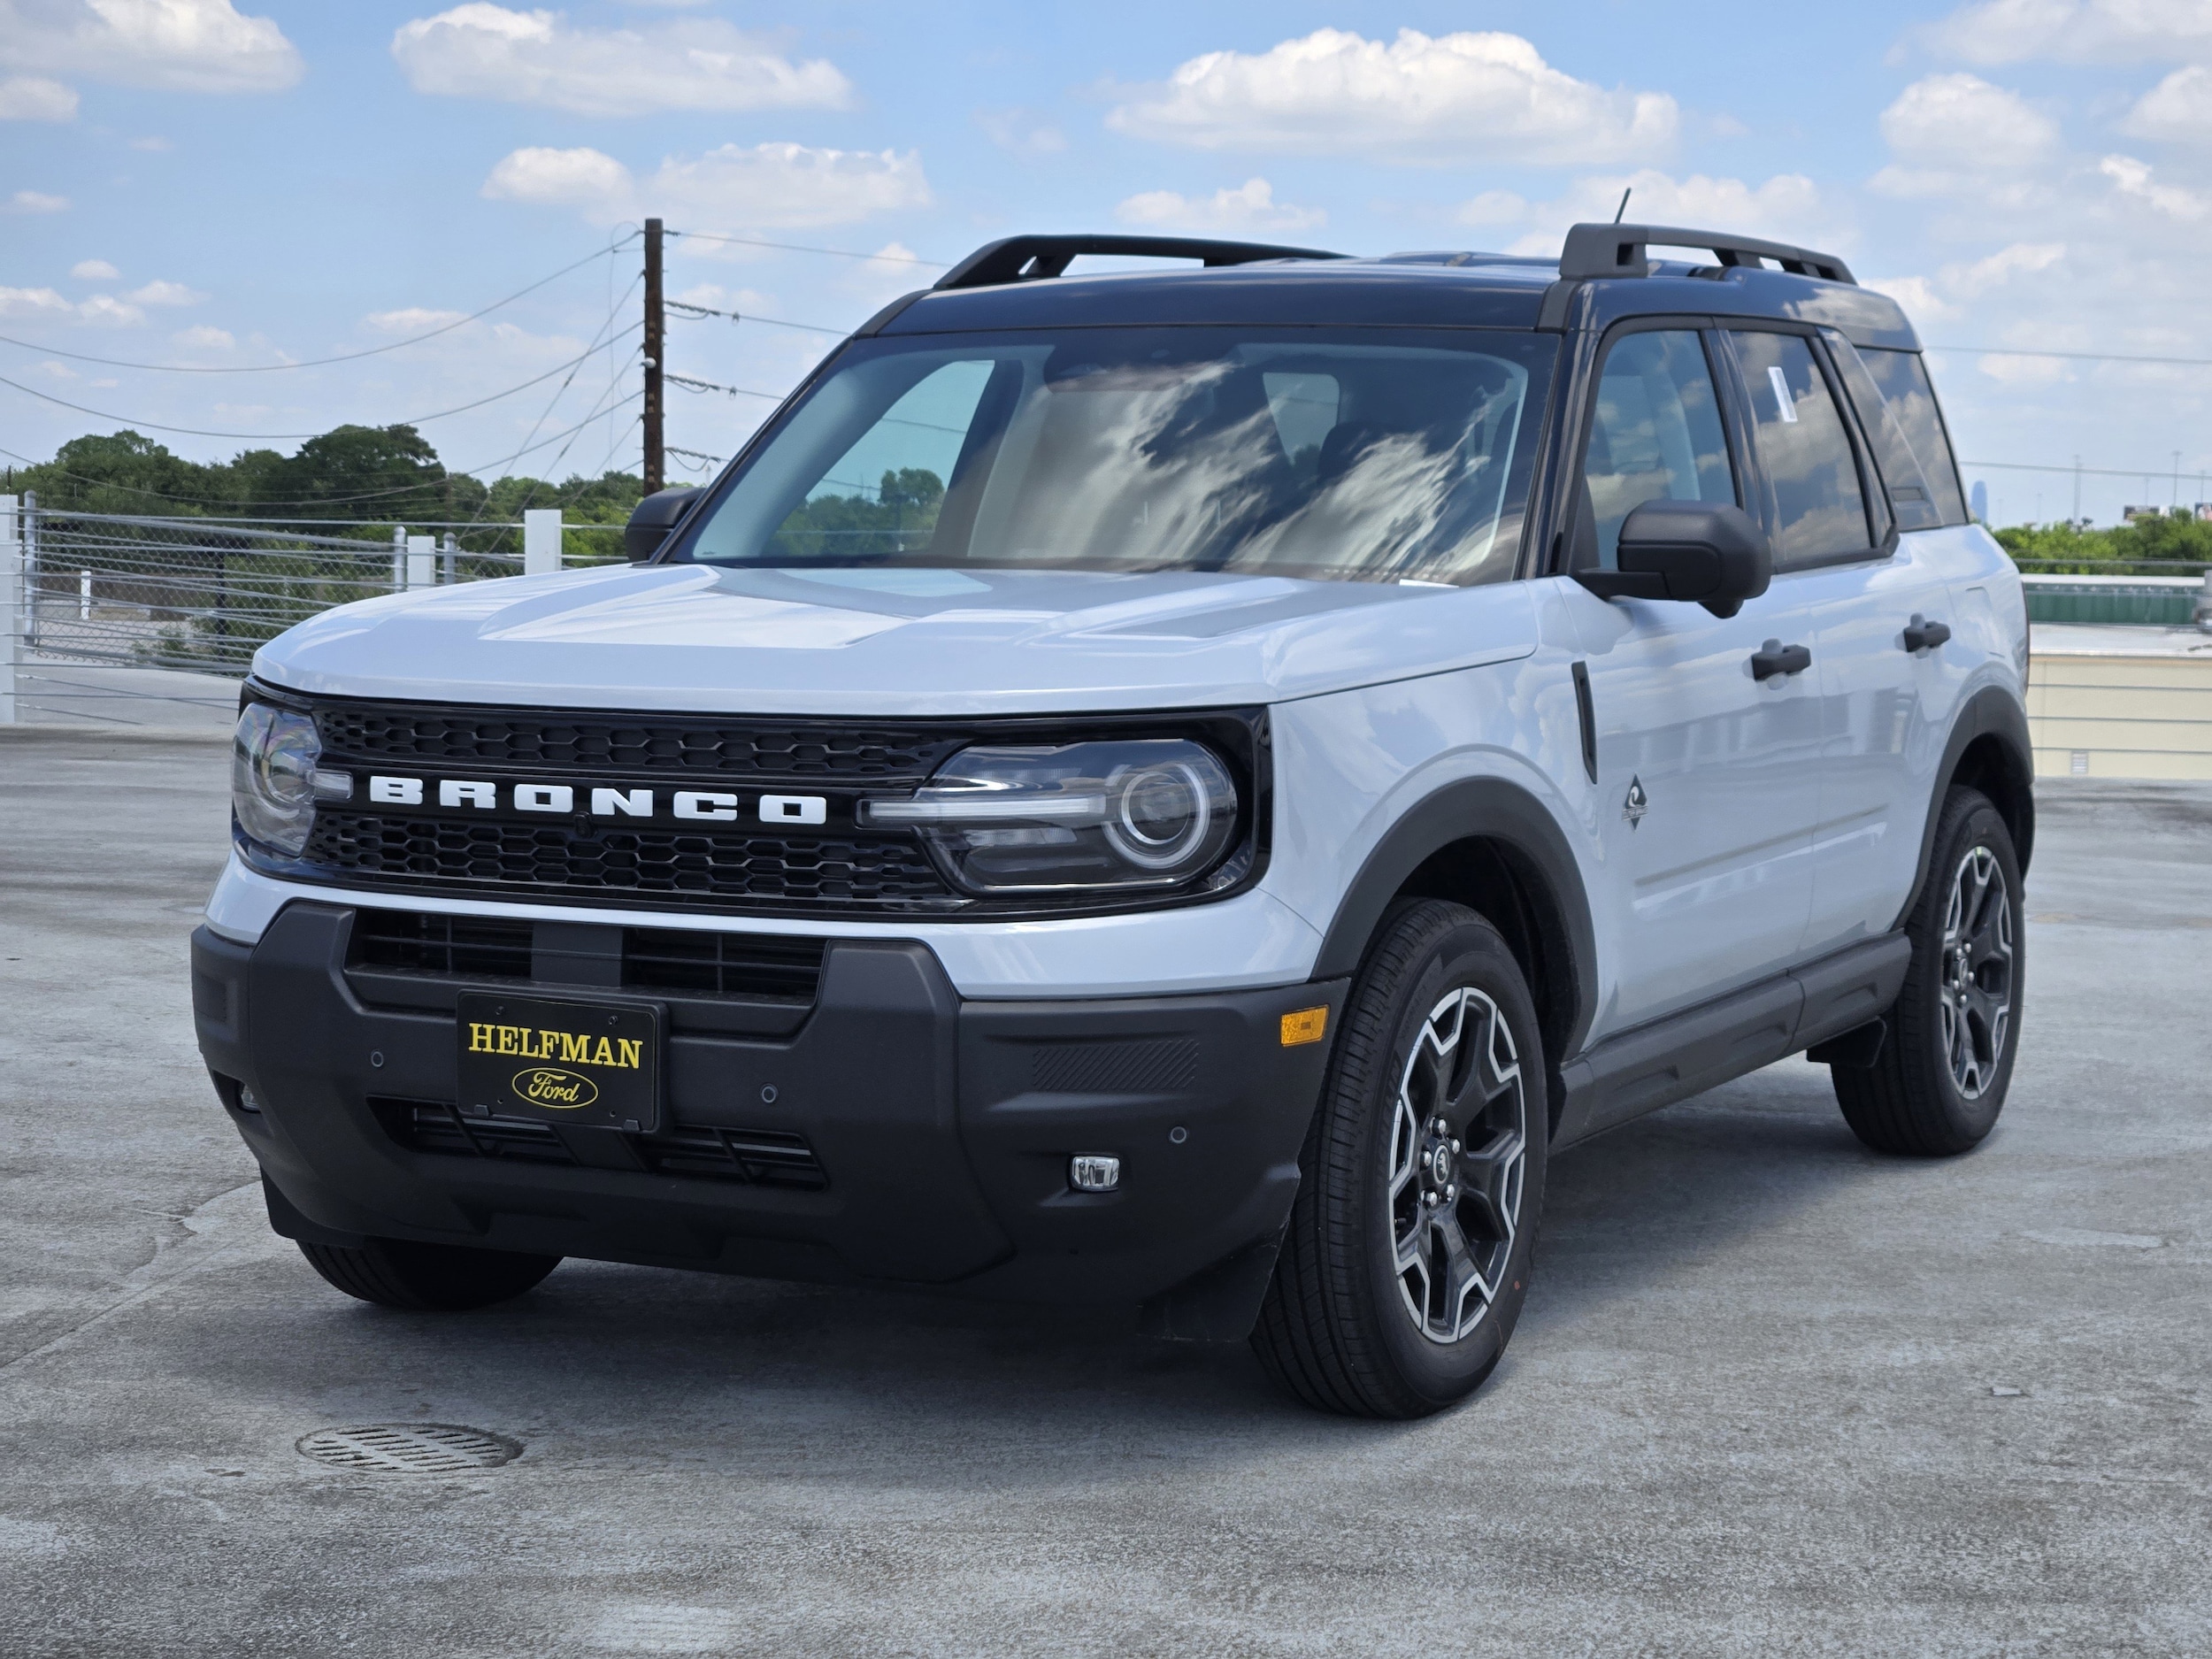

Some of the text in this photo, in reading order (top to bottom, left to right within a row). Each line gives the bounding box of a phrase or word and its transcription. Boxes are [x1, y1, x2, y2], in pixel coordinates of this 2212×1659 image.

[370, 775, 826, 825] BRONCO
[468, 1022, 643, 1069] HELFMAN
[527, 1071, 580, 1102] Ford
